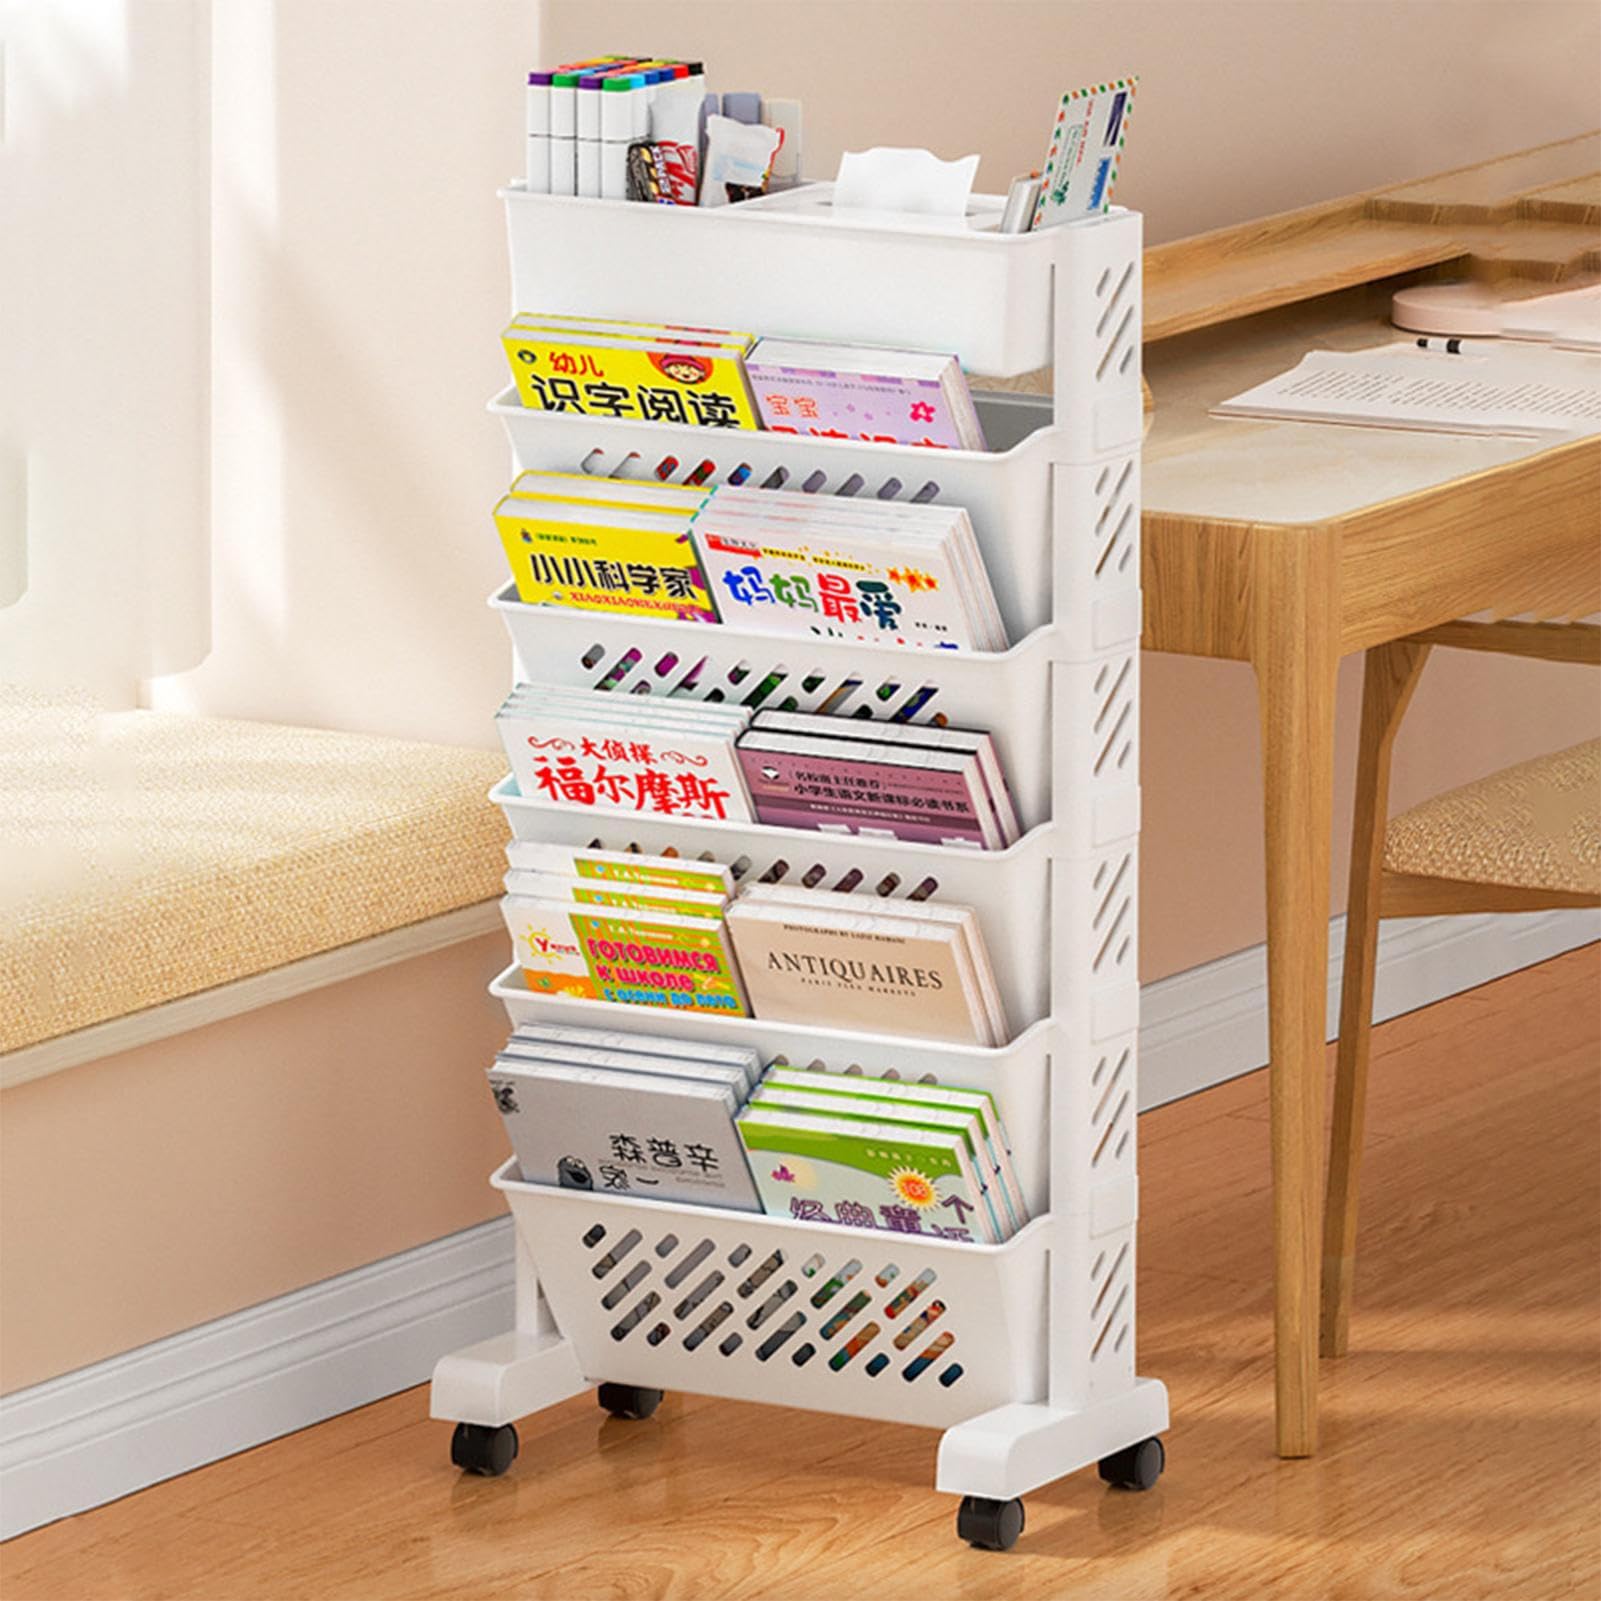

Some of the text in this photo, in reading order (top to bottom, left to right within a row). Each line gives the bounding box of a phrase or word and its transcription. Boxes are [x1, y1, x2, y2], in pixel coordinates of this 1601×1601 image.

[549, 351, 604, 378] 幼儿
[531, 373, 740, 430] 识字阅读
[766, 393, 820, 419] 宝宝
[529, 553, 698, 600] 小小科学家
[722, 565, 902, 632] 妈妈最爱
[579, 736, 658, 765] 大侦探
[533, 755, 731, 820] 福尔摩斯
[768, 951, 944, 990] ANTIQUAIRES
